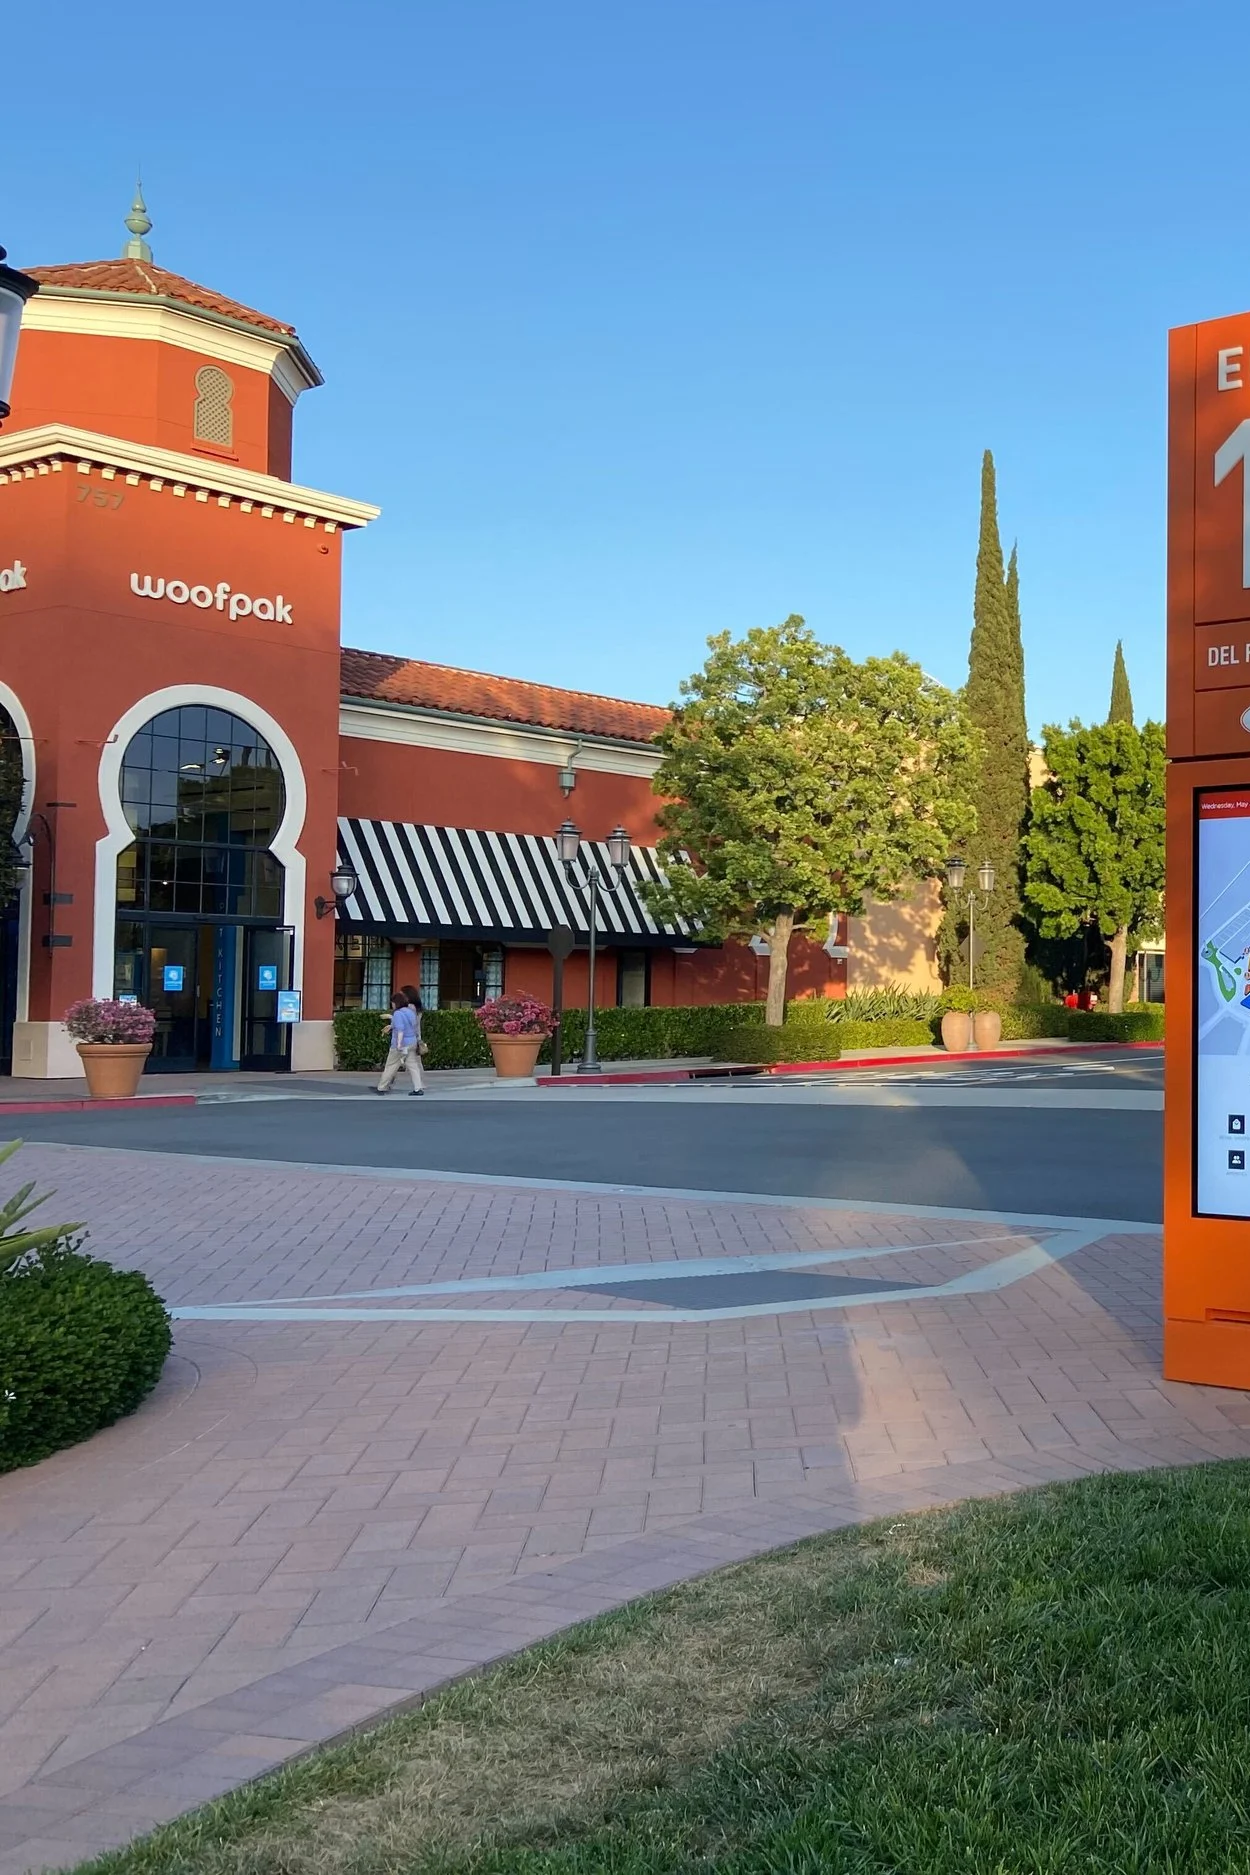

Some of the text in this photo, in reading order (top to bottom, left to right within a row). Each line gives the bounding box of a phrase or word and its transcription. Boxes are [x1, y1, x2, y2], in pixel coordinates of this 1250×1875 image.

[75, 483, 125, 511] 757
[130, 572, 294, 625] woofpak
[1207, 645, 1240, 667] DEL
[1236, 801, 1249, 809] May
[215, 949, 224, 1037] KITCHEN
